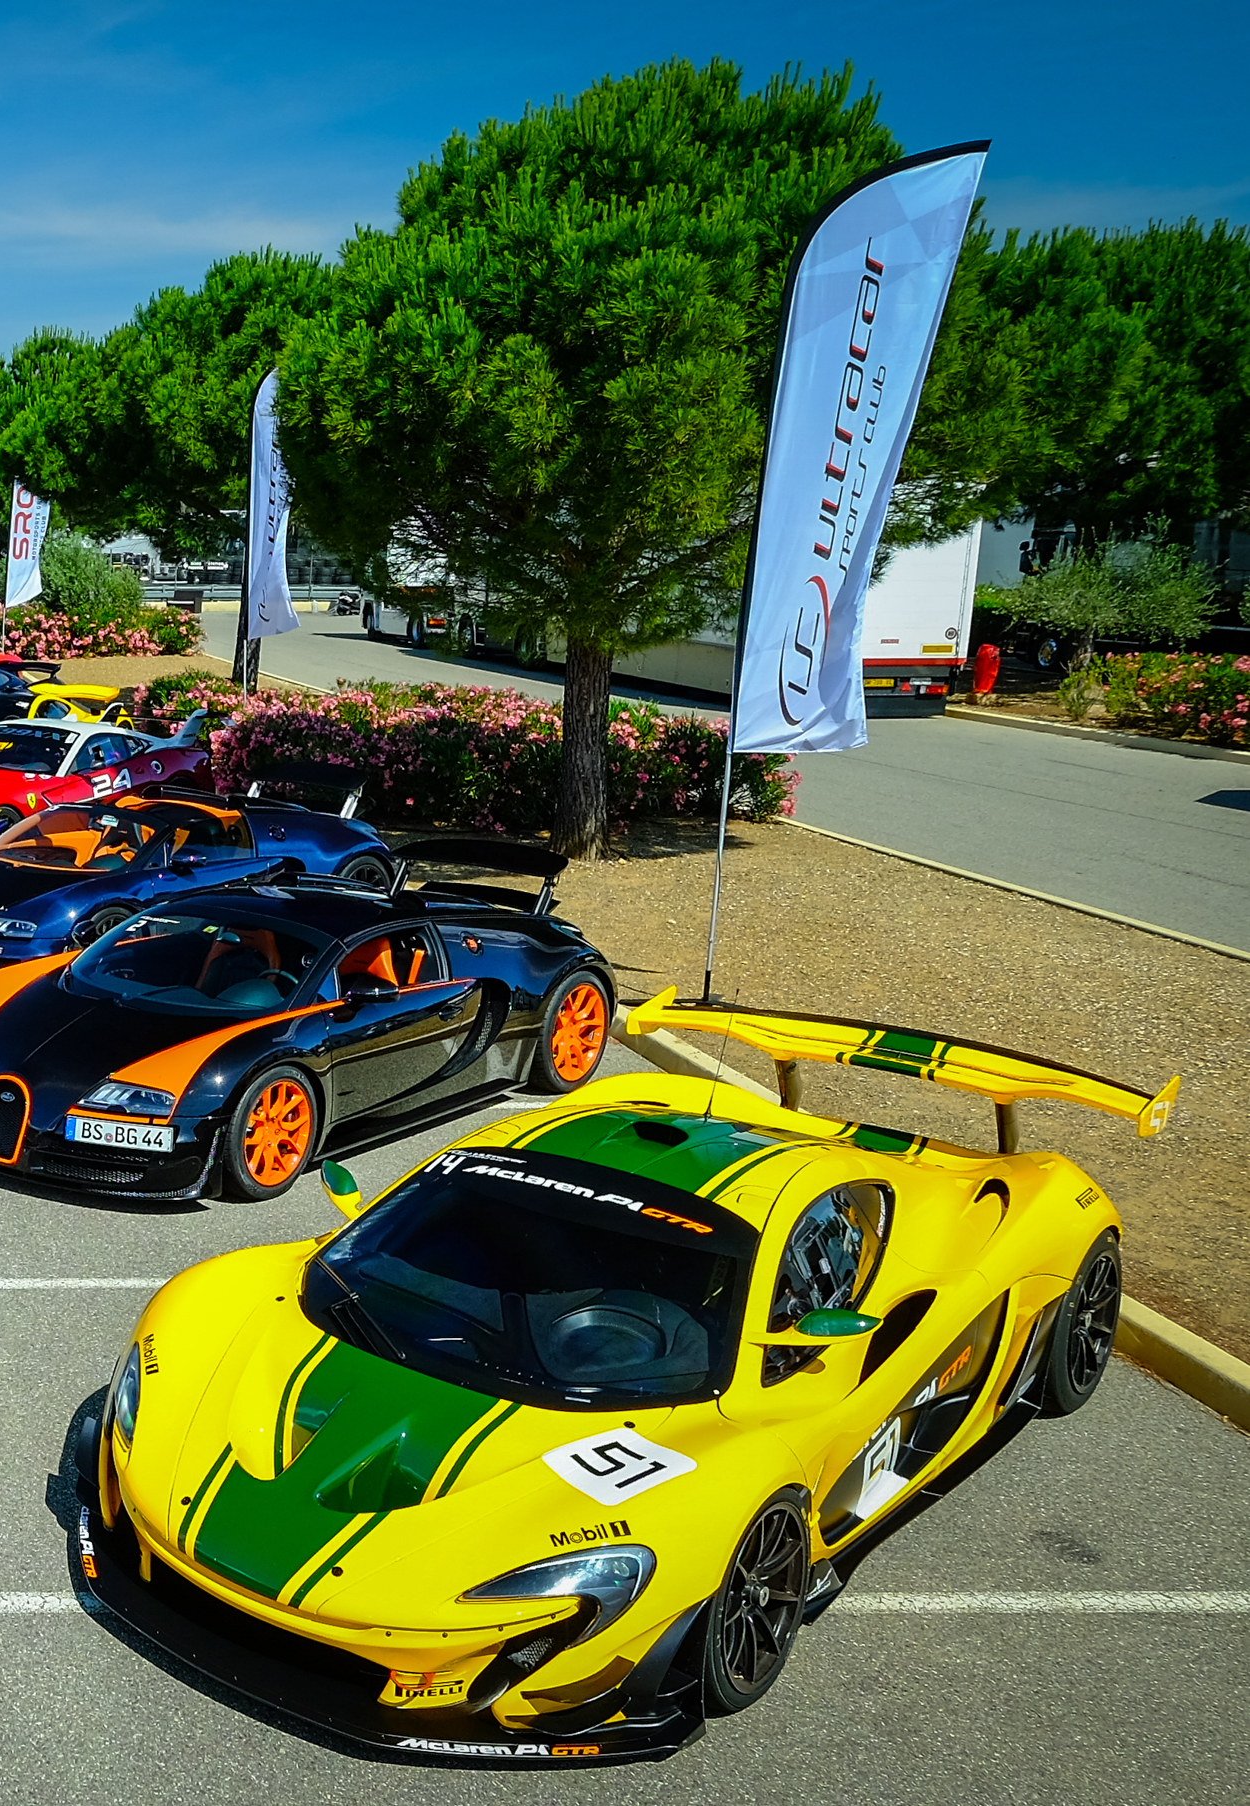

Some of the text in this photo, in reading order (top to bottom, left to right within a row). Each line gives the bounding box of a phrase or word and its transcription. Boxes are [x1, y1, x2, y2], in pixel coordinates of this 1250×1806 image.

[863, 365, 887, 444] club
[12, 485, 37, 560] SRO
[91, 767, 132, 798] 24
[81, 1122, 164, 1148] BS BG 44
[423, 1154, 467, 1175] 14
[462, 1165, 714, 1235] McLaren P1 GTR
[143, 1333, 159, 1376] Mobil 1
[937, 1345, 972, 1392] GTR
[570, 1441, 668, 1489] 51
[549, 1520, 632, 1547] Mobil 1
[82, 1554, 98, 1579] GTR
[397, 1738, 601, 1756] McLaren P1 GTR
